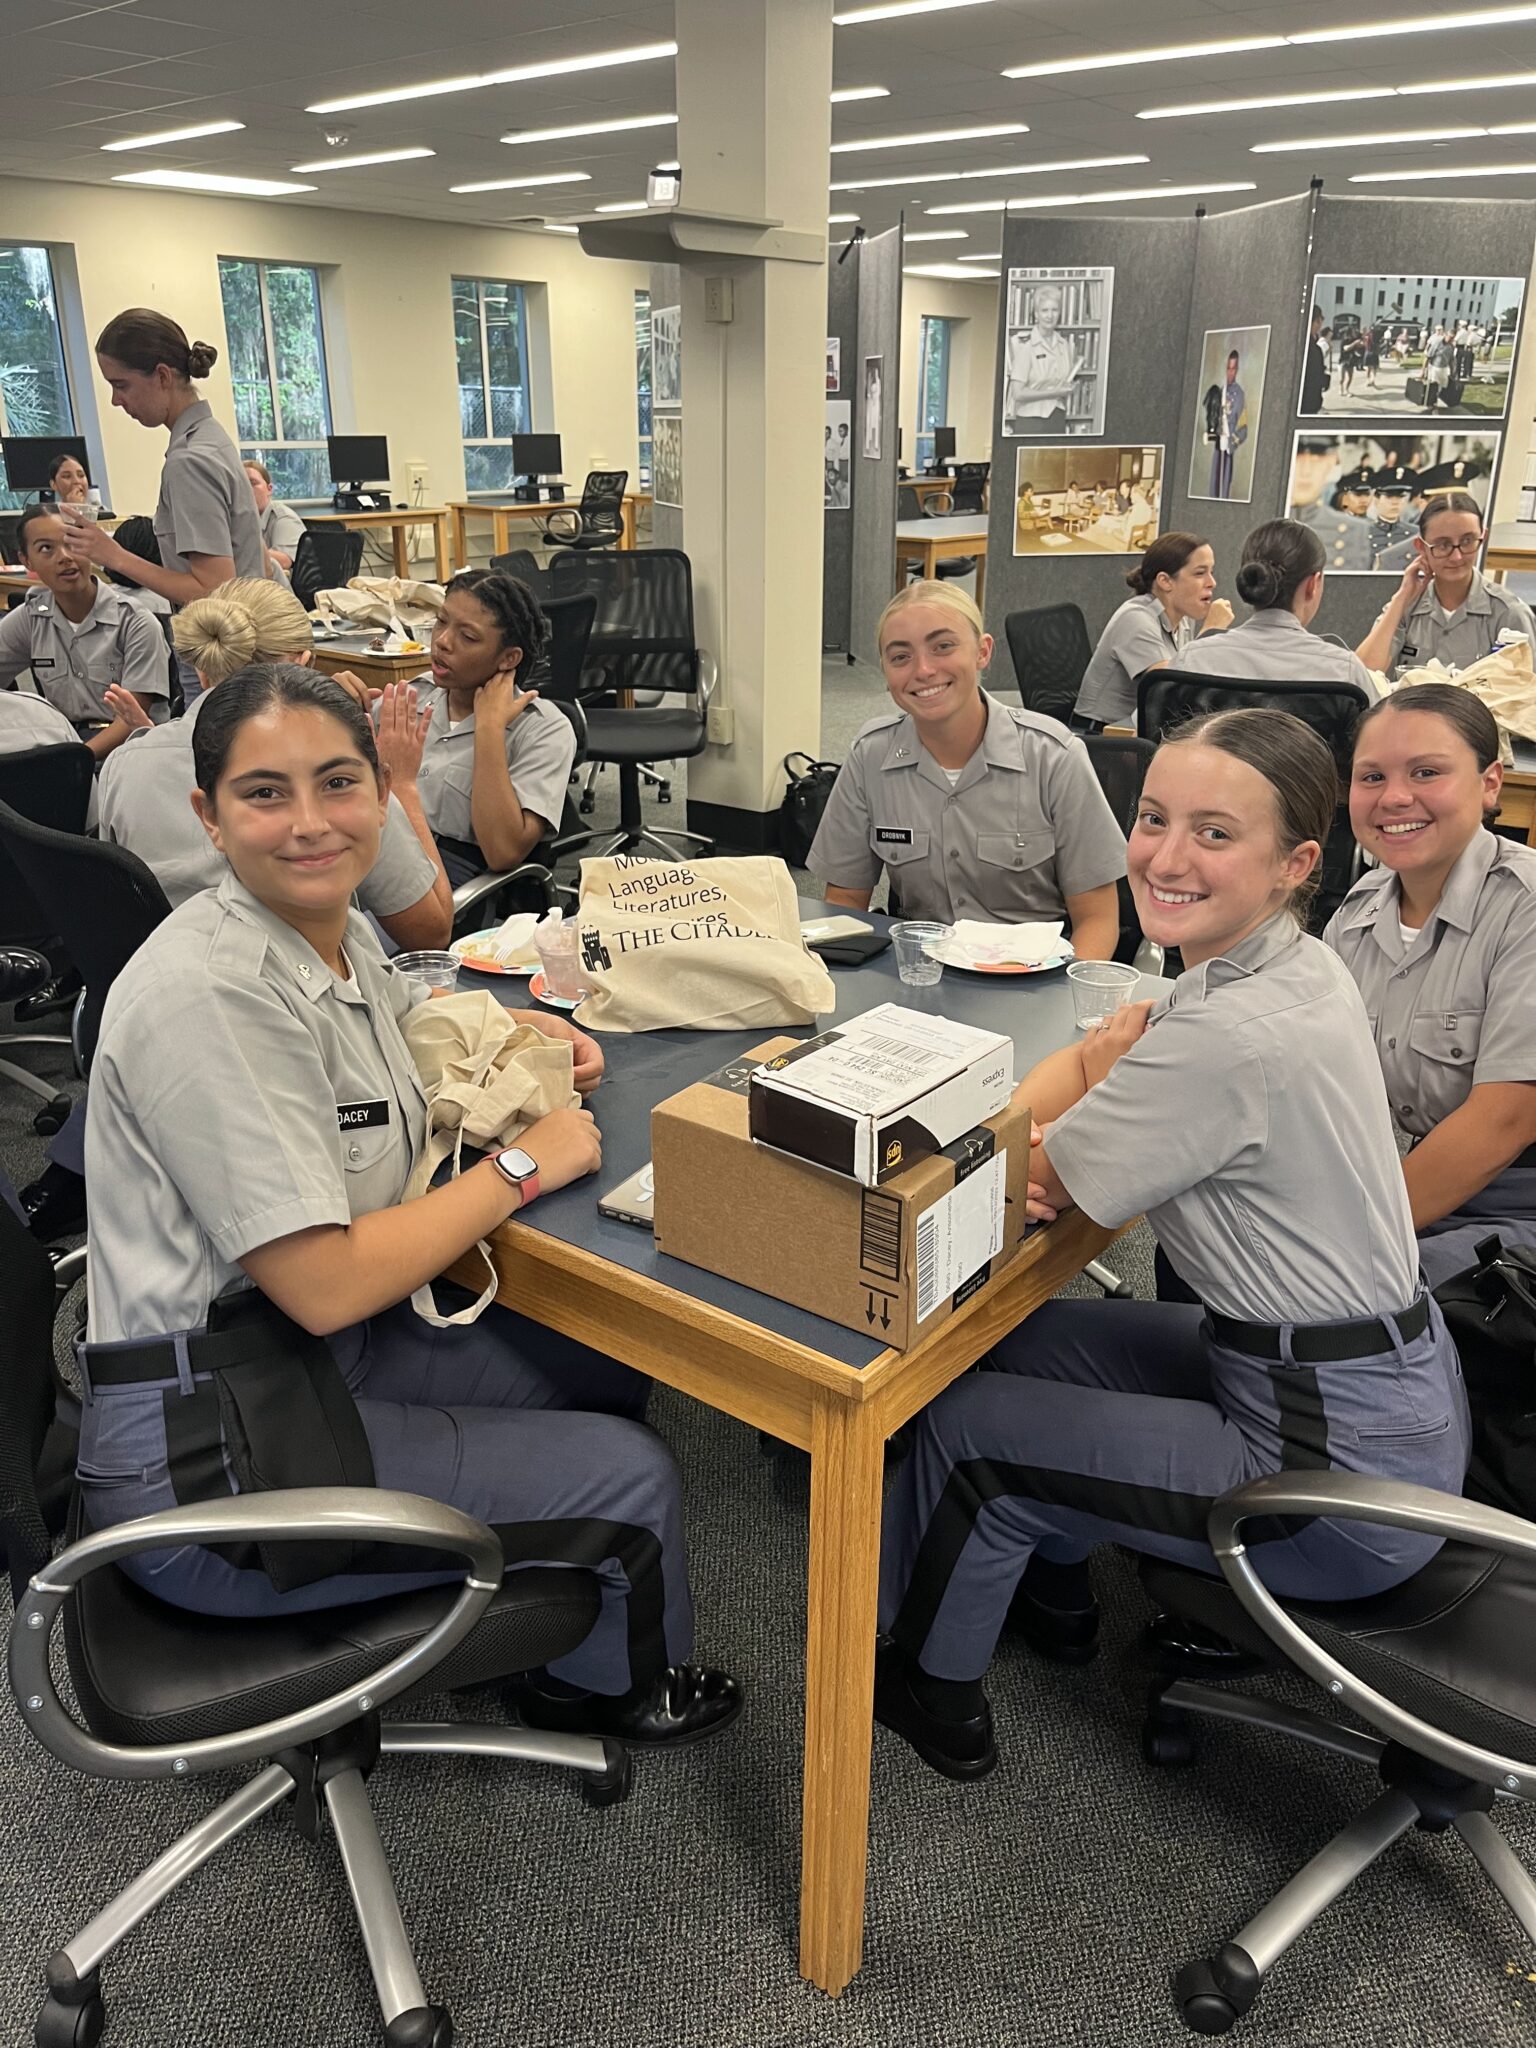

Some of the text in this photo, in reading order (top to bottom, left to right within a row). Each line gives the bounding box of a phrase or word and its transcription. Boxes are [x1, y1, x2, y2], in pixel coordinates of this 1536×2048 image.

[612, 922, 778, 952] THE CITAD
[982, 1067, 1005, 1088] Express
[337, 1109, 369, 1125] DACEY
